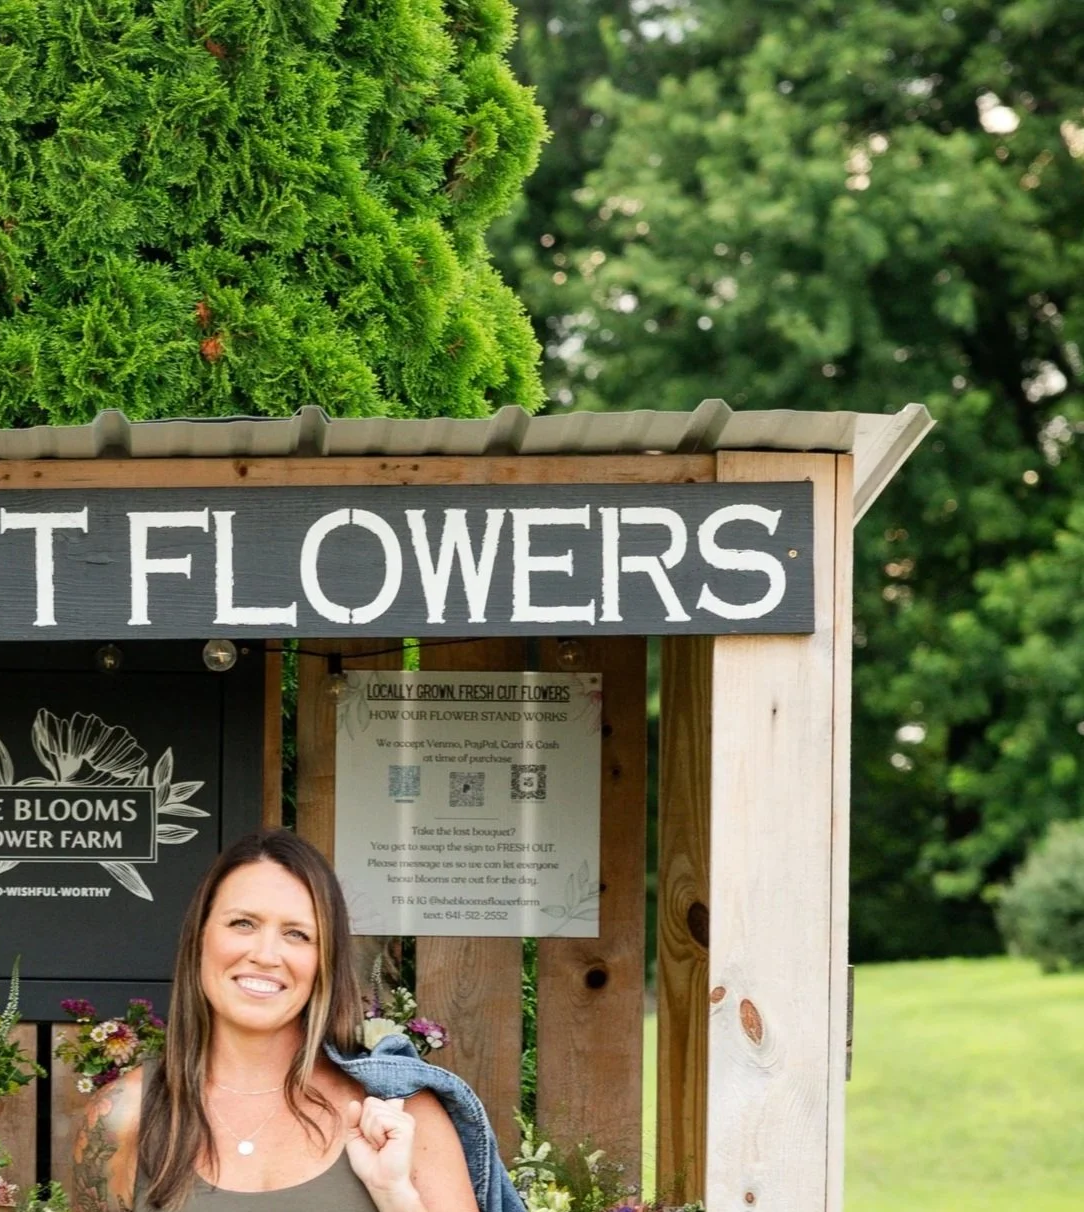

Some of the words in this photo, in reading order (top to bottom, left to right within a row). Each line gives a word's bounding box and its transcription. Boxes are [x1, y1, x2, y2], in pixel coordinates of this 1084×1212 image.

[126, 503, 787, 627] FLOWERS
[367, 684, 412, 700] LOCALLY
[459, 684, 494, 700] FRESH
[498, 684, 517, 700] CUT
[521, 684, 570, 700] FLOWERS
[369, 710, 398, 721] HOW
[402, 710, 427, 721] OUR
[430, 710, 478, 721] FLOWER
[481, 710, 521, 721] STAND
[525, 710, 567, 721] WORKS
[376, 739, 391, 749] We
[393, 739, 424, 749] accept
[501, 739, 524, 749] Card
[526, 739, 533, 749] &
[536, 739, 559, 749] Cash
[423, 753, 433, 764] at
[435, 753, 455, 764] time
[458, 753, 468, 764] of
[469, 753, 512, 764] purchase
[14, 798, 138, 822] BLOOMS
[412, 826, 434, 836] Take
[437, 826, 454, 836] the
[456, 826, 470, 836] last
[472, 826, 515, 836] bouquet?
[61, 830, 123, 849] FARM
[371, 841, 389, 852] You
[391, 841, 405, 852] get
[407, 841, 417, 852] to
[419, 841, 444, 852] swap
[447, 841, 462, 852] the
[464, 841, 483, 852] sign
[485, 841, 495, 852] to
[497, 841, 529, 852] FRESH
[368, 858, 397, 869] Please
[400, 858, 440, 869] message
[443, 858, 453, 869] us
[456, 858, 466, 869] so
[468, 858, 481, 869] we
[484, 858, 501, 869] can
[503, 858, 514, 869] let
[516, 858, 559, 869] everyone
[387, 874, 412, 885] know
[415, 874, 449, 885] blooms
[451, 874, 470, 885] are
[472, 874, 484, 885] out
[486, 874, 499, 885] for
[501, 874, 516, 885] the
[392, 896, 405, 906] FB
[407, 896, 414, 906] &
[416, 896, 427, 906] IG
